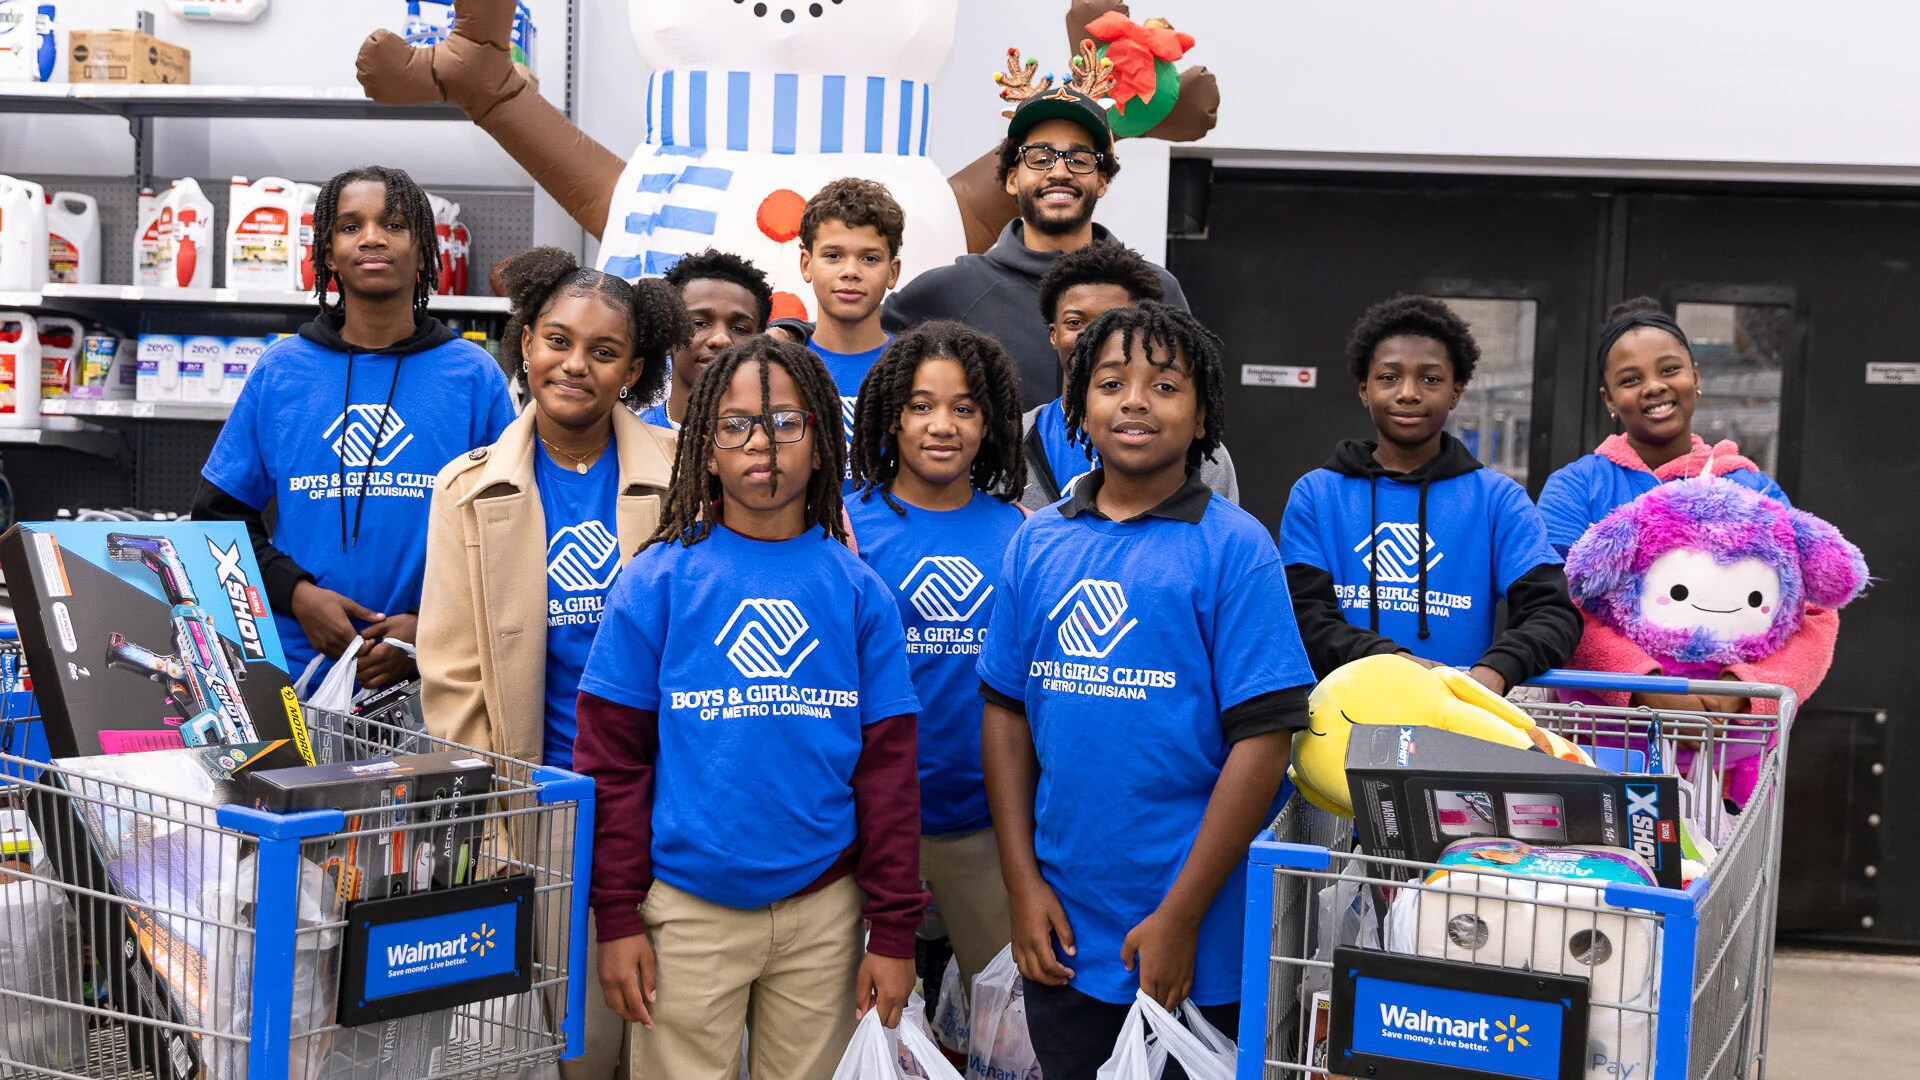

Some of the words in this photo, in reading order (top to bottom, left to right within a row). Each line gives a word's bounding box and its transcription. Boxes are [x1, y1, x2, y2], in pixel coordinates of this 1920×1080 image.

[147, 343, 174, 353] zevo
[192, 344, 220, 354] zevo
[235, 345, 263, 355] zevo
[289, 474, 329, 491] BOYS
[331, 474, 341, 487] &
[345, 472, 393, 486] GIRLS
[396, 473, 437, 488] CLUB
[309, 489, 325, 500] OF
[365, 487, 424, 498] LOUISIANA
[249, 590, 262, 614] ZURU
[549, 599, 564, 614] &
[565, 596, 605, 612] GIRL
[1333, 585, 1356, 599] BYS
[1357, 585, 1371, 599] &
[1376, 586, 1419, 603] GIRLS
[1425, 590, 1472, 610] CLUBS
[1341, 599, 1351, 609] OF
[1353, 599, 1391, 610] MERO
[1394, 602, 1450, 617] LOUIIANA
[547, 613, 586, 627] METRO
[906, 626, 921, 642] &
[924, 627, 974, 643] GIRLS
[945, 644, 981, 654] LOUISI
[4, 656, 14, 692] Walmar
[1062, 663, 1109, 683] GIRLS
[1112, 667, 1176, 689] CLUBS
[671, 689, 724, 709] BOYS
[728, 687, 743, 705] &
[746, 684, 800, 702] GIRLS
[801, 688, 859, 707] CLUBS
[1042, 678, 1051, 690] OF
[1050, 679, 1076, 693] METRO
[1078, 683, 1147, 700] LOUISIANA
[700, 708, 719, 721] OF
[722, 704, 769, 719] METRO
[772, 704, 832, 719] LOUISIANA
[289, 706, 314, 766] MOTORIZE
[454, 776, 464, 786] X
[1381, 800, 1399, 838] WARNING:
[1661, 822, 1670, 840] ZURU
[387, 933, 468, 967] Walmart
[388, 968, 405, 978] Save
[405, 964, 429, 974] money.
[430, 961, 445, 970] Live
[445, 957, 468, 967] better.
[1380, 1002, 1490, 1041] Walmart
[1381, 1028, 1403, 1039] Save
[1404, 1033, 1436, 1046] money.
[1438, 1037, 1457, 1048] Live
[1458, 1040, 1490, 1053] better.
